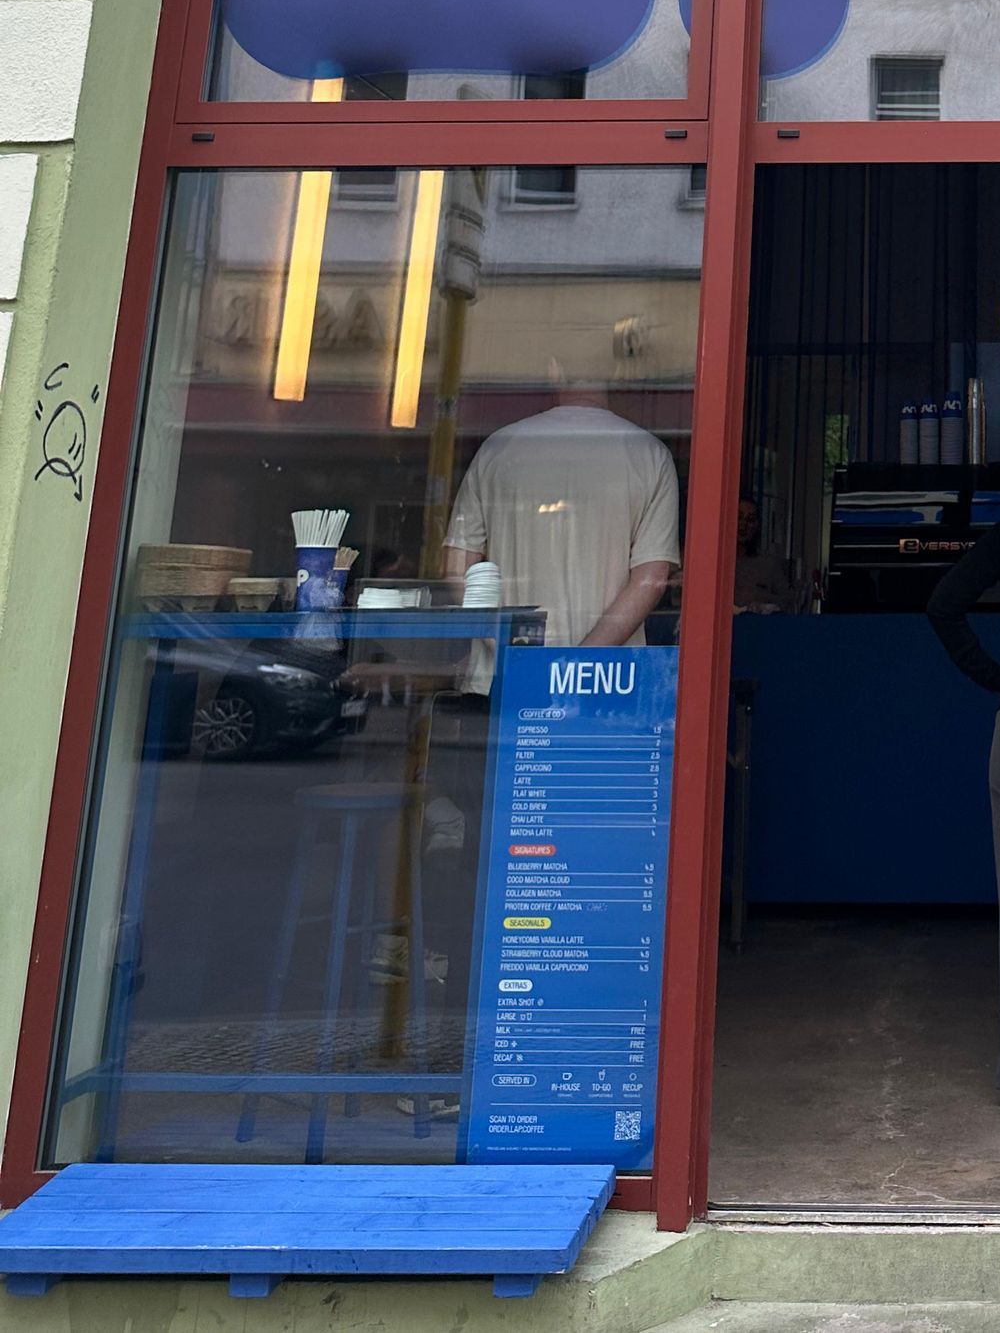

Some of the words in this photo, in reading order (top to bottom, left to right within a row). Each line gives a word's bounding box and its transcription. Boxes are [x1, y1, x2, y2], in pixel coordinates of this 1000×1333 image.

[549, 662, 636, 695] MENU
[517, 726, 549, 734] ESPRESSO
[516, 738, 551, 746] AMERICANO
[515, 751, 535, 759] FILTER
[514, 764, 553, 772] CAPPUCCINO
[513, 777, 532, 785] LATTE
[512, 790, 527, 798] FLAT
[528, 790, 546, 798] WHITE
[511, 802, 528, 811] COLD
[529, 802, 548, 810] BREW
[510, 815, 525, 823] CHAI
[526, 815, 544, 823] LATTE
[509, 828, 534, 836] MATCHA
[535, 828, 553, 836] LATTE
[507, 862, 542, 871] BLUEBERRY
[543, 862, 568, 870] MATCHA
[506, 876, 524, 884] COCO
[524, 876, 549, 884] MATCHA
[549, 876, 571, 884] CLOUD
[505, 889, 537, 897] COLLAGEN
[537, 889, 562, 897] MATCHA
[504, 902, 529, 911] PROTEIN
[530, 902, 552, 911] COFFEE
[557, 903, 582, 911] MATCHA
[509, 919, 545, 927] SEASONALS
[502, 935, 540, 944] HONEYCOMB
[540, 936, 565, 944] VANILLA
[566, 936, 584, 944] LATTE
[501, 949, 542, 958] STRAWBERRY
[542, 949, 563, 958] CLOUD
[563, 950, 588, 958] MATCHA
[500, 963, 525, 971] FREDDO
[525, 963, 550, 971] VANILLA
[550, 963, 589, 972] CAPPUCCINO
[503, 981, 528, 989] EXTRAS
[497, 998, 517, 1006] EXTRA
[518, 998, 535, 1006] SHOT
[496, 1012, 517, 1021] LARGE
[495, 1026, 511, 1034] MILK
[630, 1026, 646, 1035] FREE
[494, 1039, 509, 1048] ICED
[629, 1040, 645, 1049] FREE
[493, 1053, 514, 1062] DECAF
[629, 1054, 645, 1063] FREE
[498, 1076, 523, 1085] SERVED
[551, 1083, 581, 1092] IN-HOUSE
[592, 1083, 612, 1091] TO-GO
[622, 1083, 643, 1092] RECUP
[489, 1115, 507, 1123] SCAN
[507, 1115, 516, 1123] TO
[516, 1115, 538, 1123] ORDER
